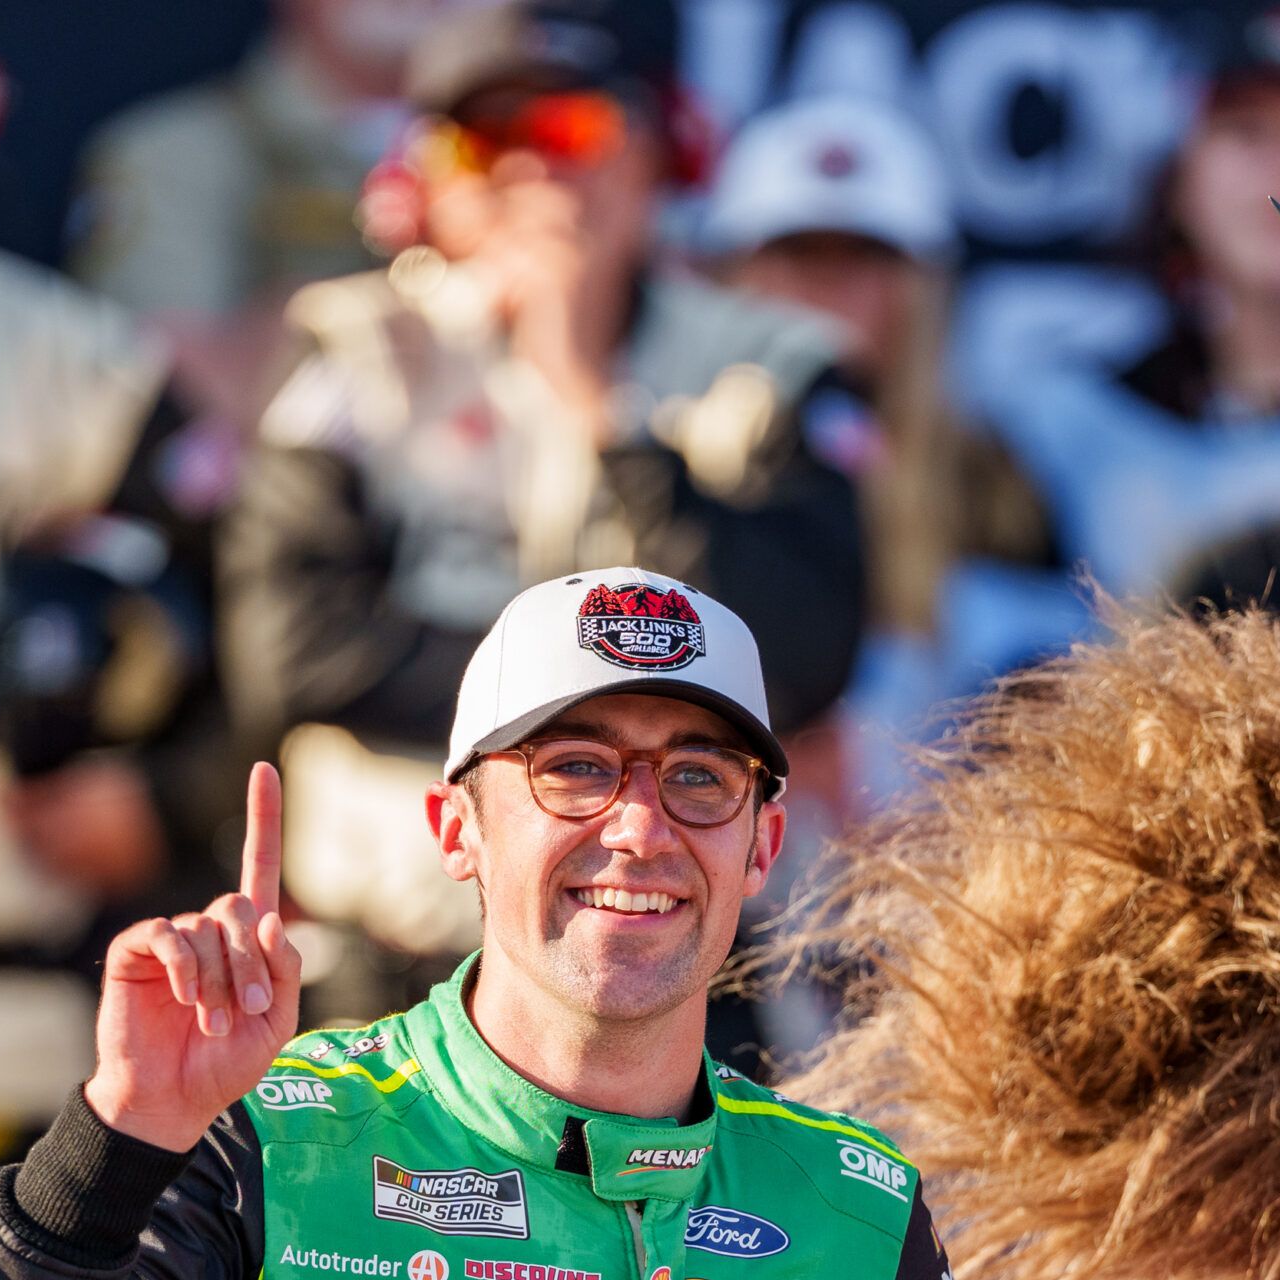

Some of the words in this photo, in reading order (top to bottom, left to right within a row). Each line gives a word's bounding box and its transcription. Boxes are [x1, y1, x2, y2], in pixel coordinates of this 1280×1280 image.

[598, 620, 640, 633] JACK
[641, 620, 686, 637] LINK'S
[620, 632, 671, 647] 500
[256, 1081, 333, 1104] OMP
[839, 1146, 907, 1191] OMP
[418, 1174, 499, 1198] NASCAR
[396, 1193, 432, 1215] CUP
[434, 1203, 504, 1222] SERIES
[685, 1213, 762, 1251] Ford
[280, 1244, 402, 1277] Autotrader
